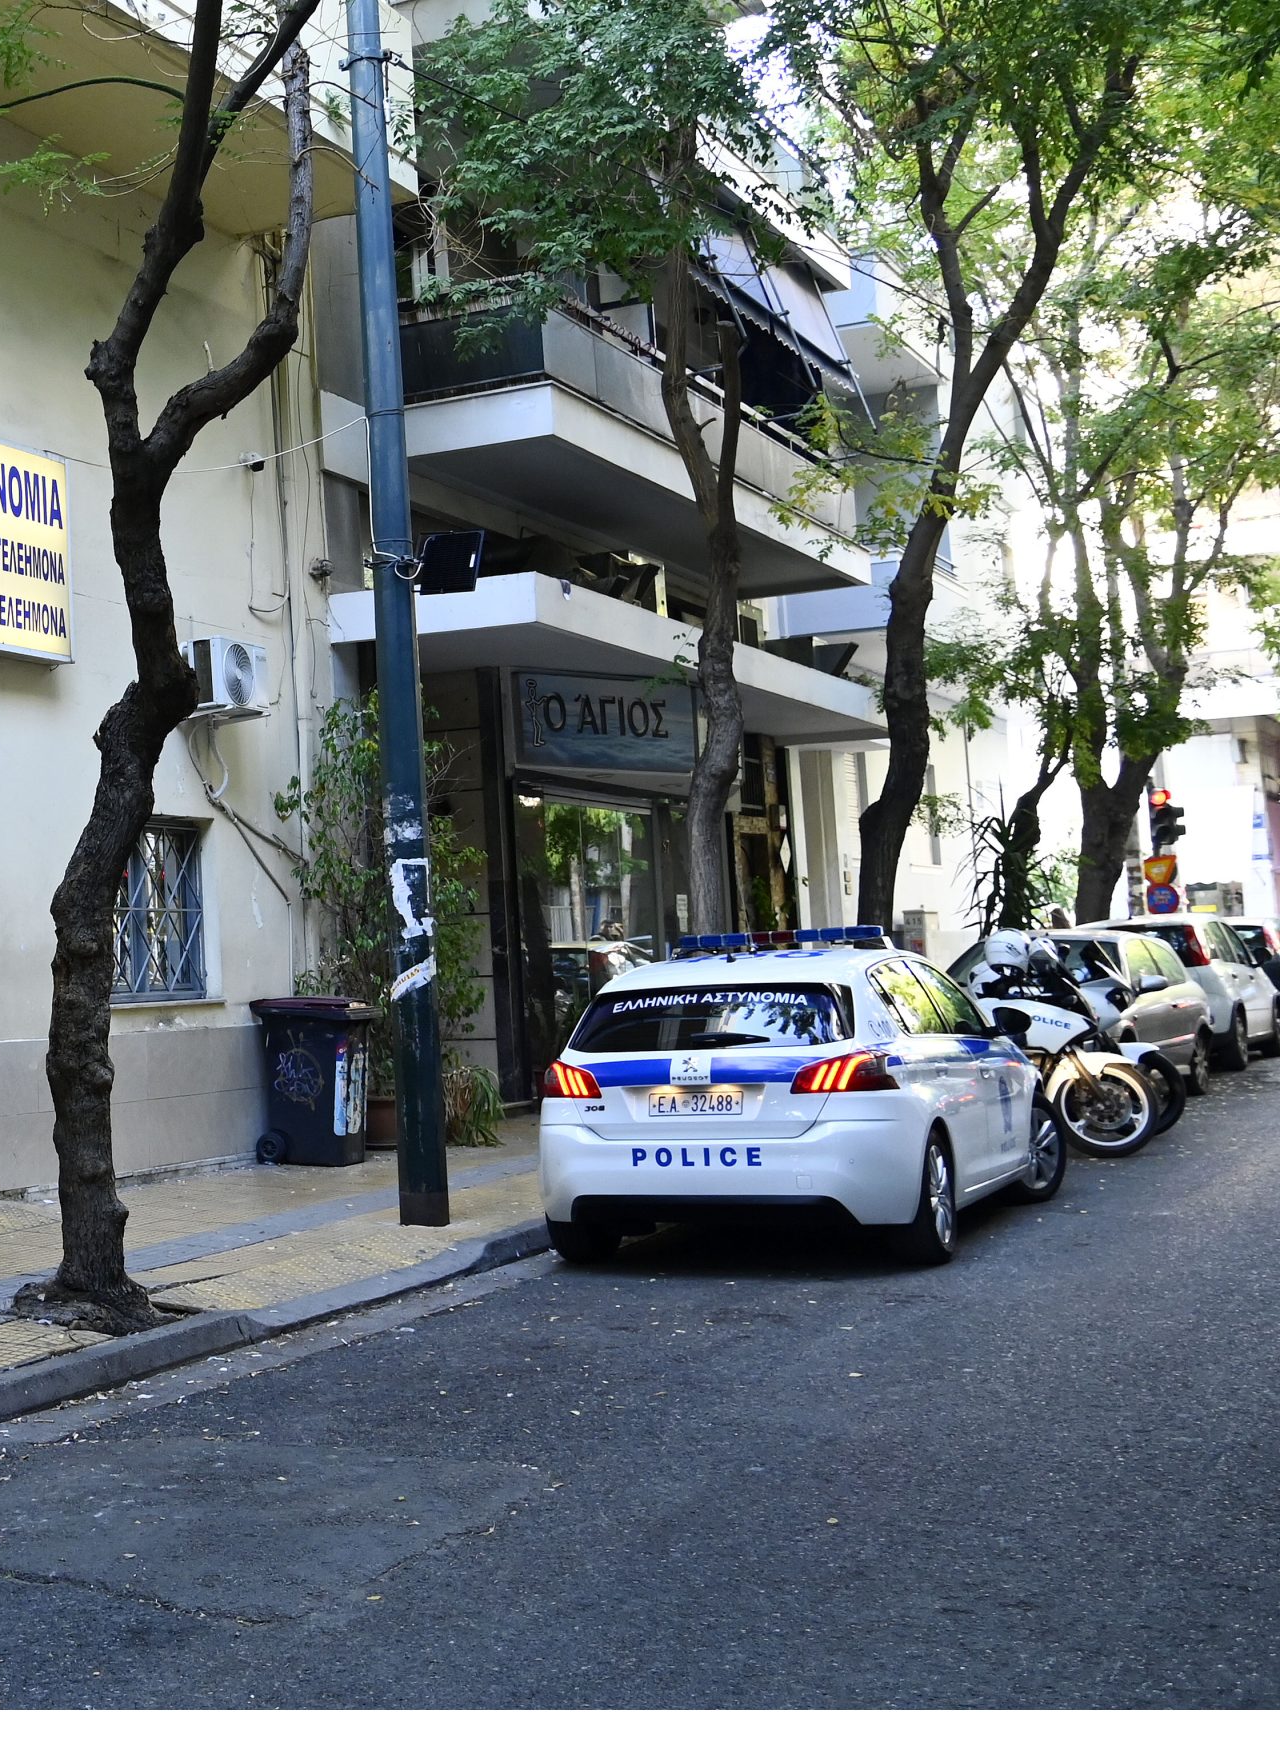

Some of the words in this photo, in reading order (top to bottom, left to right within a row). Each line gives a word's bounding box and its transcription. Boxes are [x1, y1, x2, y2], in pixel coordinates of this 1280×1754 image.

[543, 691, 567, 732] Ο
[612, 993, 698, 1014] ΕΛΛΗΝΙΚΗ
[701, 991, 808, 1006] ΑΣΤΥΝΟΜΙΑ
[1031, 1015, 1071, 1030] OLICE
[691, 1095, 733, 1113] 32488
[631, 1147, 762, 1168] POLICE
